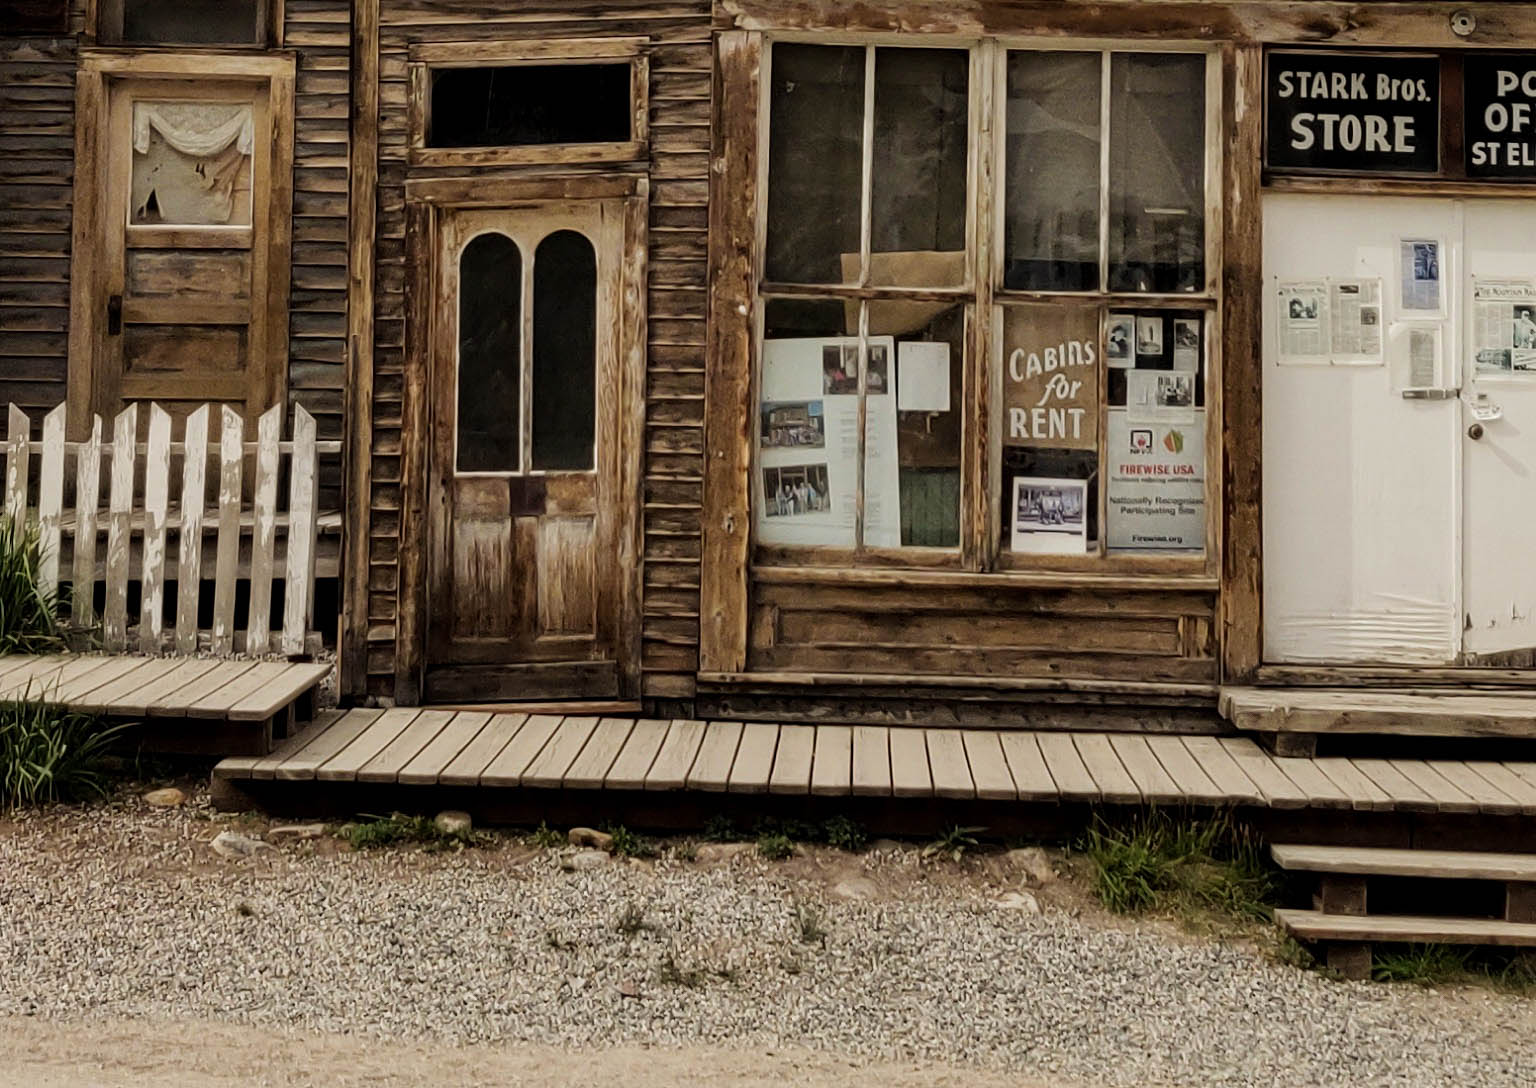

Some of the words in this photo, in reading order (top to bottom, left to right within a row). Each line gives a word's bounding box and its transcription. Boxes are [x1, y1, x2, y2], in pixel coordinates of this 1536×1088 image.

[1278, 71, 1368, 100] STARK
[1376, 73, 1431, 102] Bros.
[1291, 113, 1416, 153] STORE
[1472, 141, 1499, 166] ST
[1036, 373, 1082, 407] for
[1009, 407, 1086, 439] RENT
[1120, 464, 1170, 475] FIREWISE
[1172, 464, 1195, 475] USA
